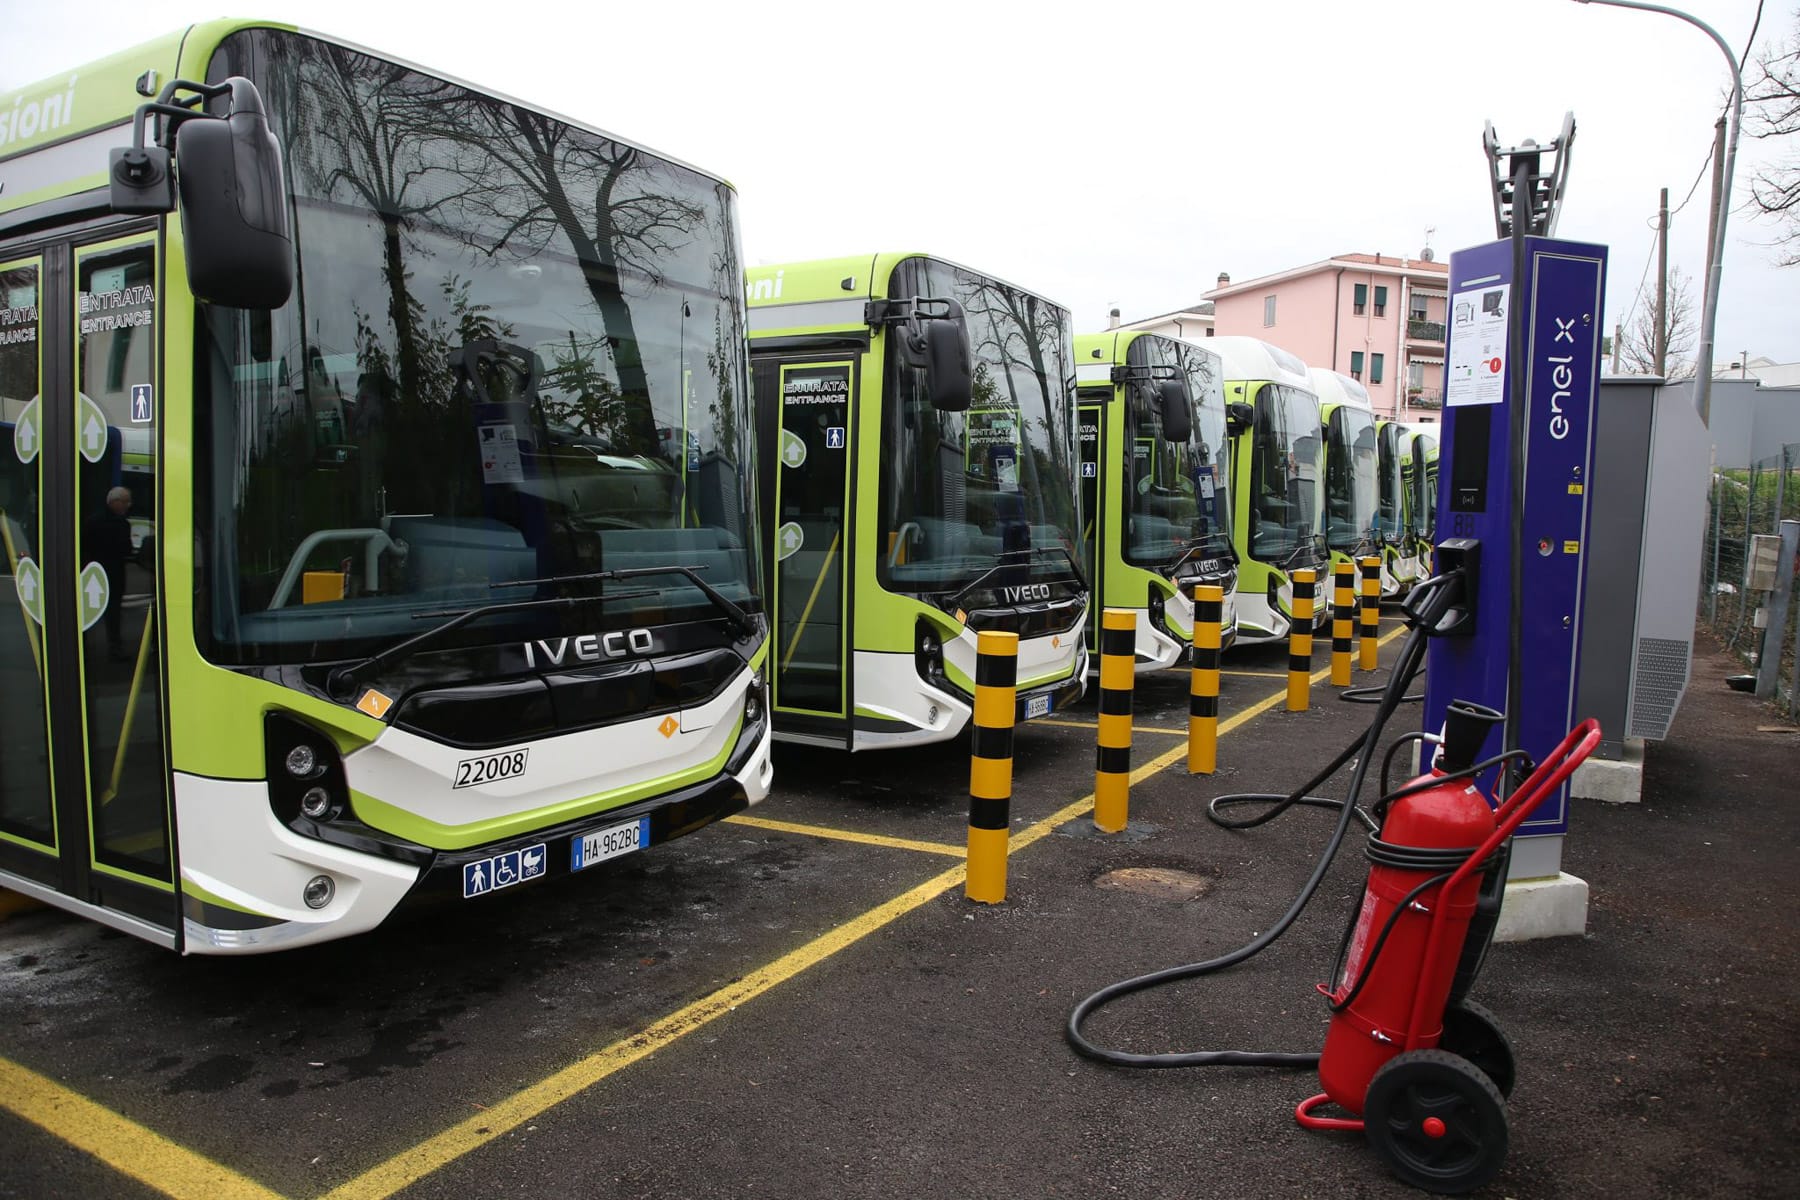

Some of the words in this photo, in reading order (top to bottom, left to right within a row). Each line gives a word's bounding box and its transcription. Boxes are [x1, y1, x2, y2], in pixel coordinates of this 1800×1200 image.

[79, 285, 154, 313] ENTRATA
[81, 310, 152, 334] ENTRANCE
[784, 380, 848, 393] ENTRATA
[785, 394, 846, 405] ENTRANCE
[1549, 356, 1574, 440] enel
[1194, 560, 1218, 571] IVECO
[1004, 584, 1050, 603] IVECO
[524, 629, 653, 668] IVECO
[458, 752, 524, 786] 22008
[584, 837, 599, 862] HA
[603, 825, 640, 855] 962BC
